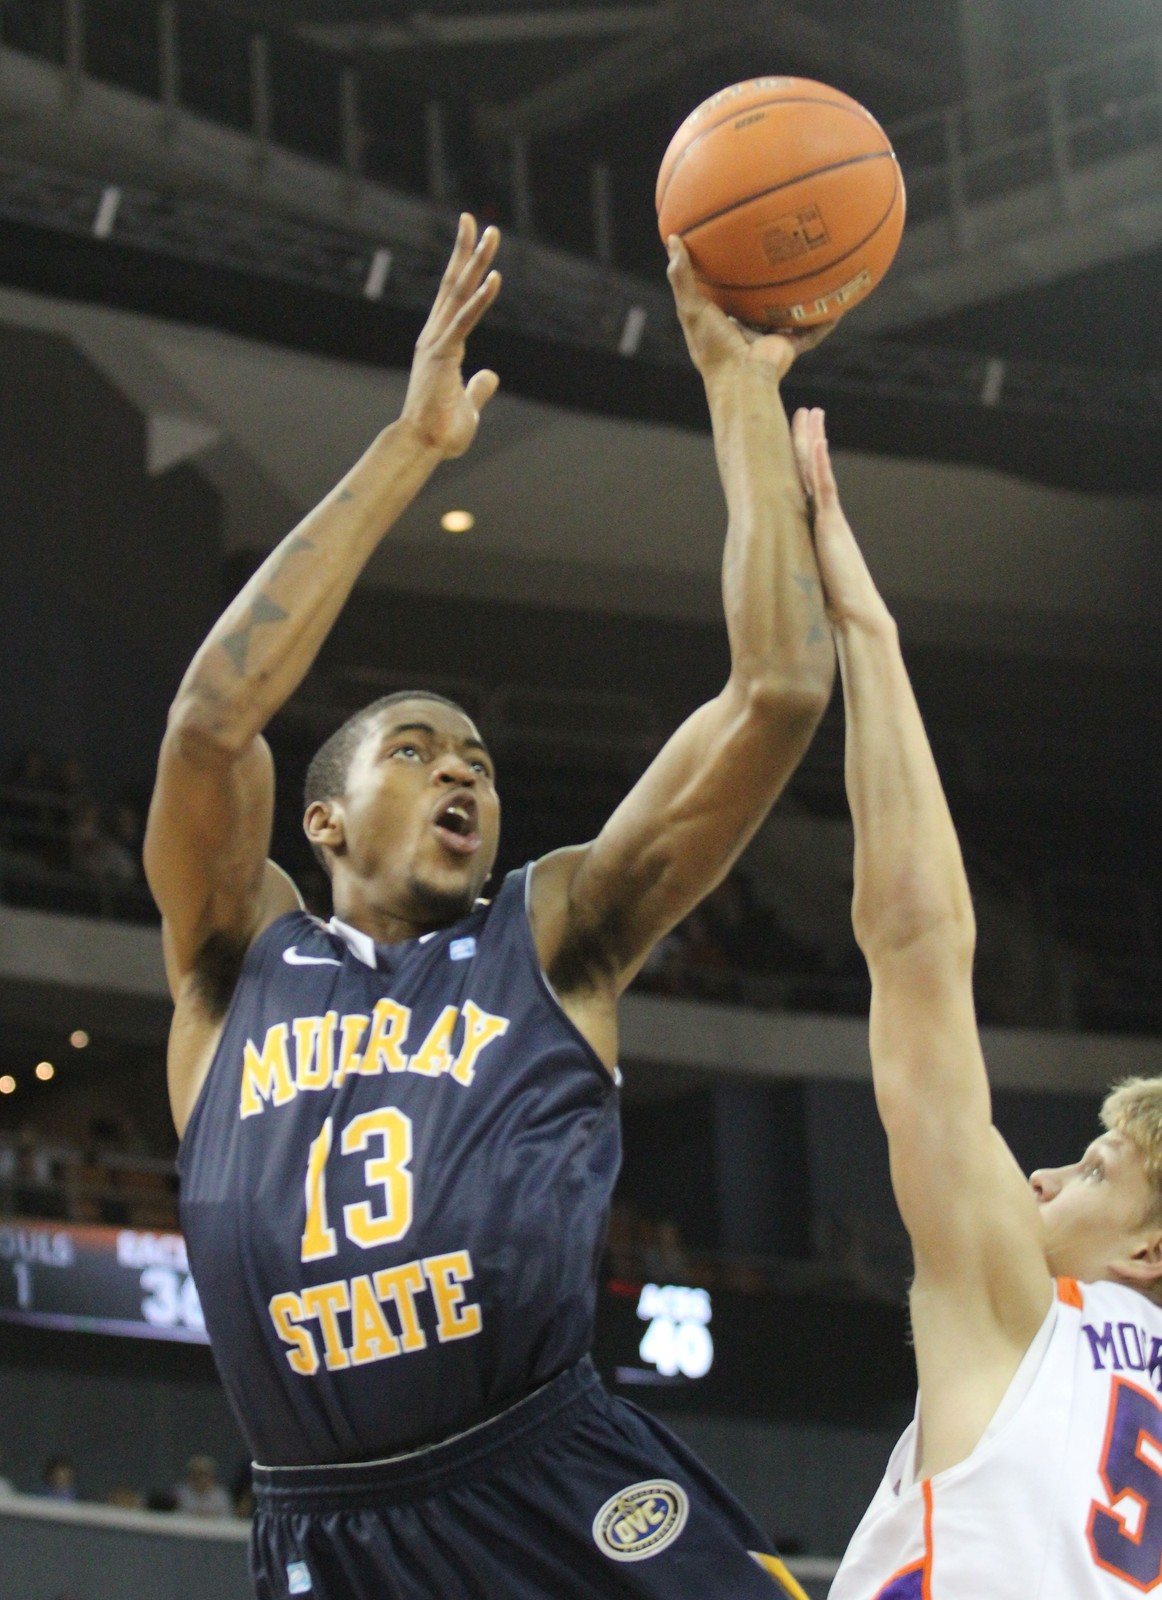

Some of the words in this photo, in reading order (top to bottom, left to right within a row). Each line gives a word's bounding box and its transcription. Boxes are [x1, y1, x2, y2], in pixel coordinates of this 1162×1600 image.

[301, 1106, 412, 1262] 13
[269, 1250, 482, 1375] STATE
[613, 1498, 666, 1545] OVC
